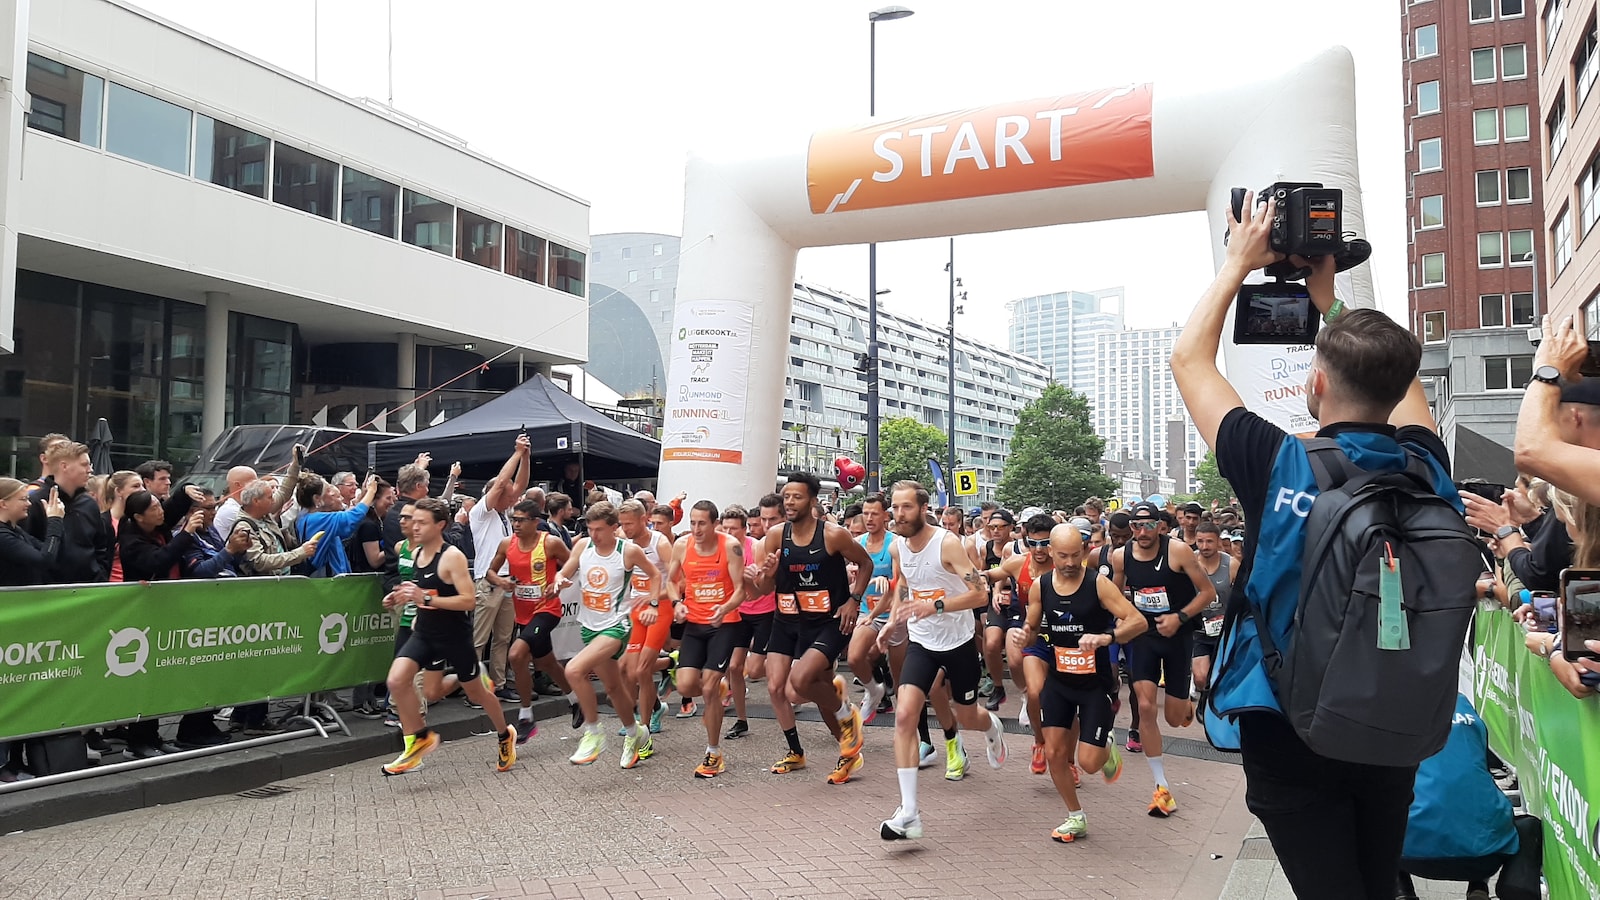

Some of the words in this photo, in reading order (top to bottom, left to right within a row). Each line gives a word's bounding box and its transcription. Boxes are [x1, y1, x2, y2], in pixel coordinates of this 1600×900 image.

[871, 106, 1080, 183] START
[1271, 358, 1311, 380] RIJNM
[960, 474, 972, 491] B
[157, 621, 304, 651] UITGEKOOKT.NL
[155, 656, 188, 667] Lekker,
[189, 651, 224, 665] gezond
[237, 649, 262, 658] lekker
[263, 643, 303, 656] makkelijk
[1058, 655, 1086, 666] 5560
[28, 665, 83, 681] makkelijk
